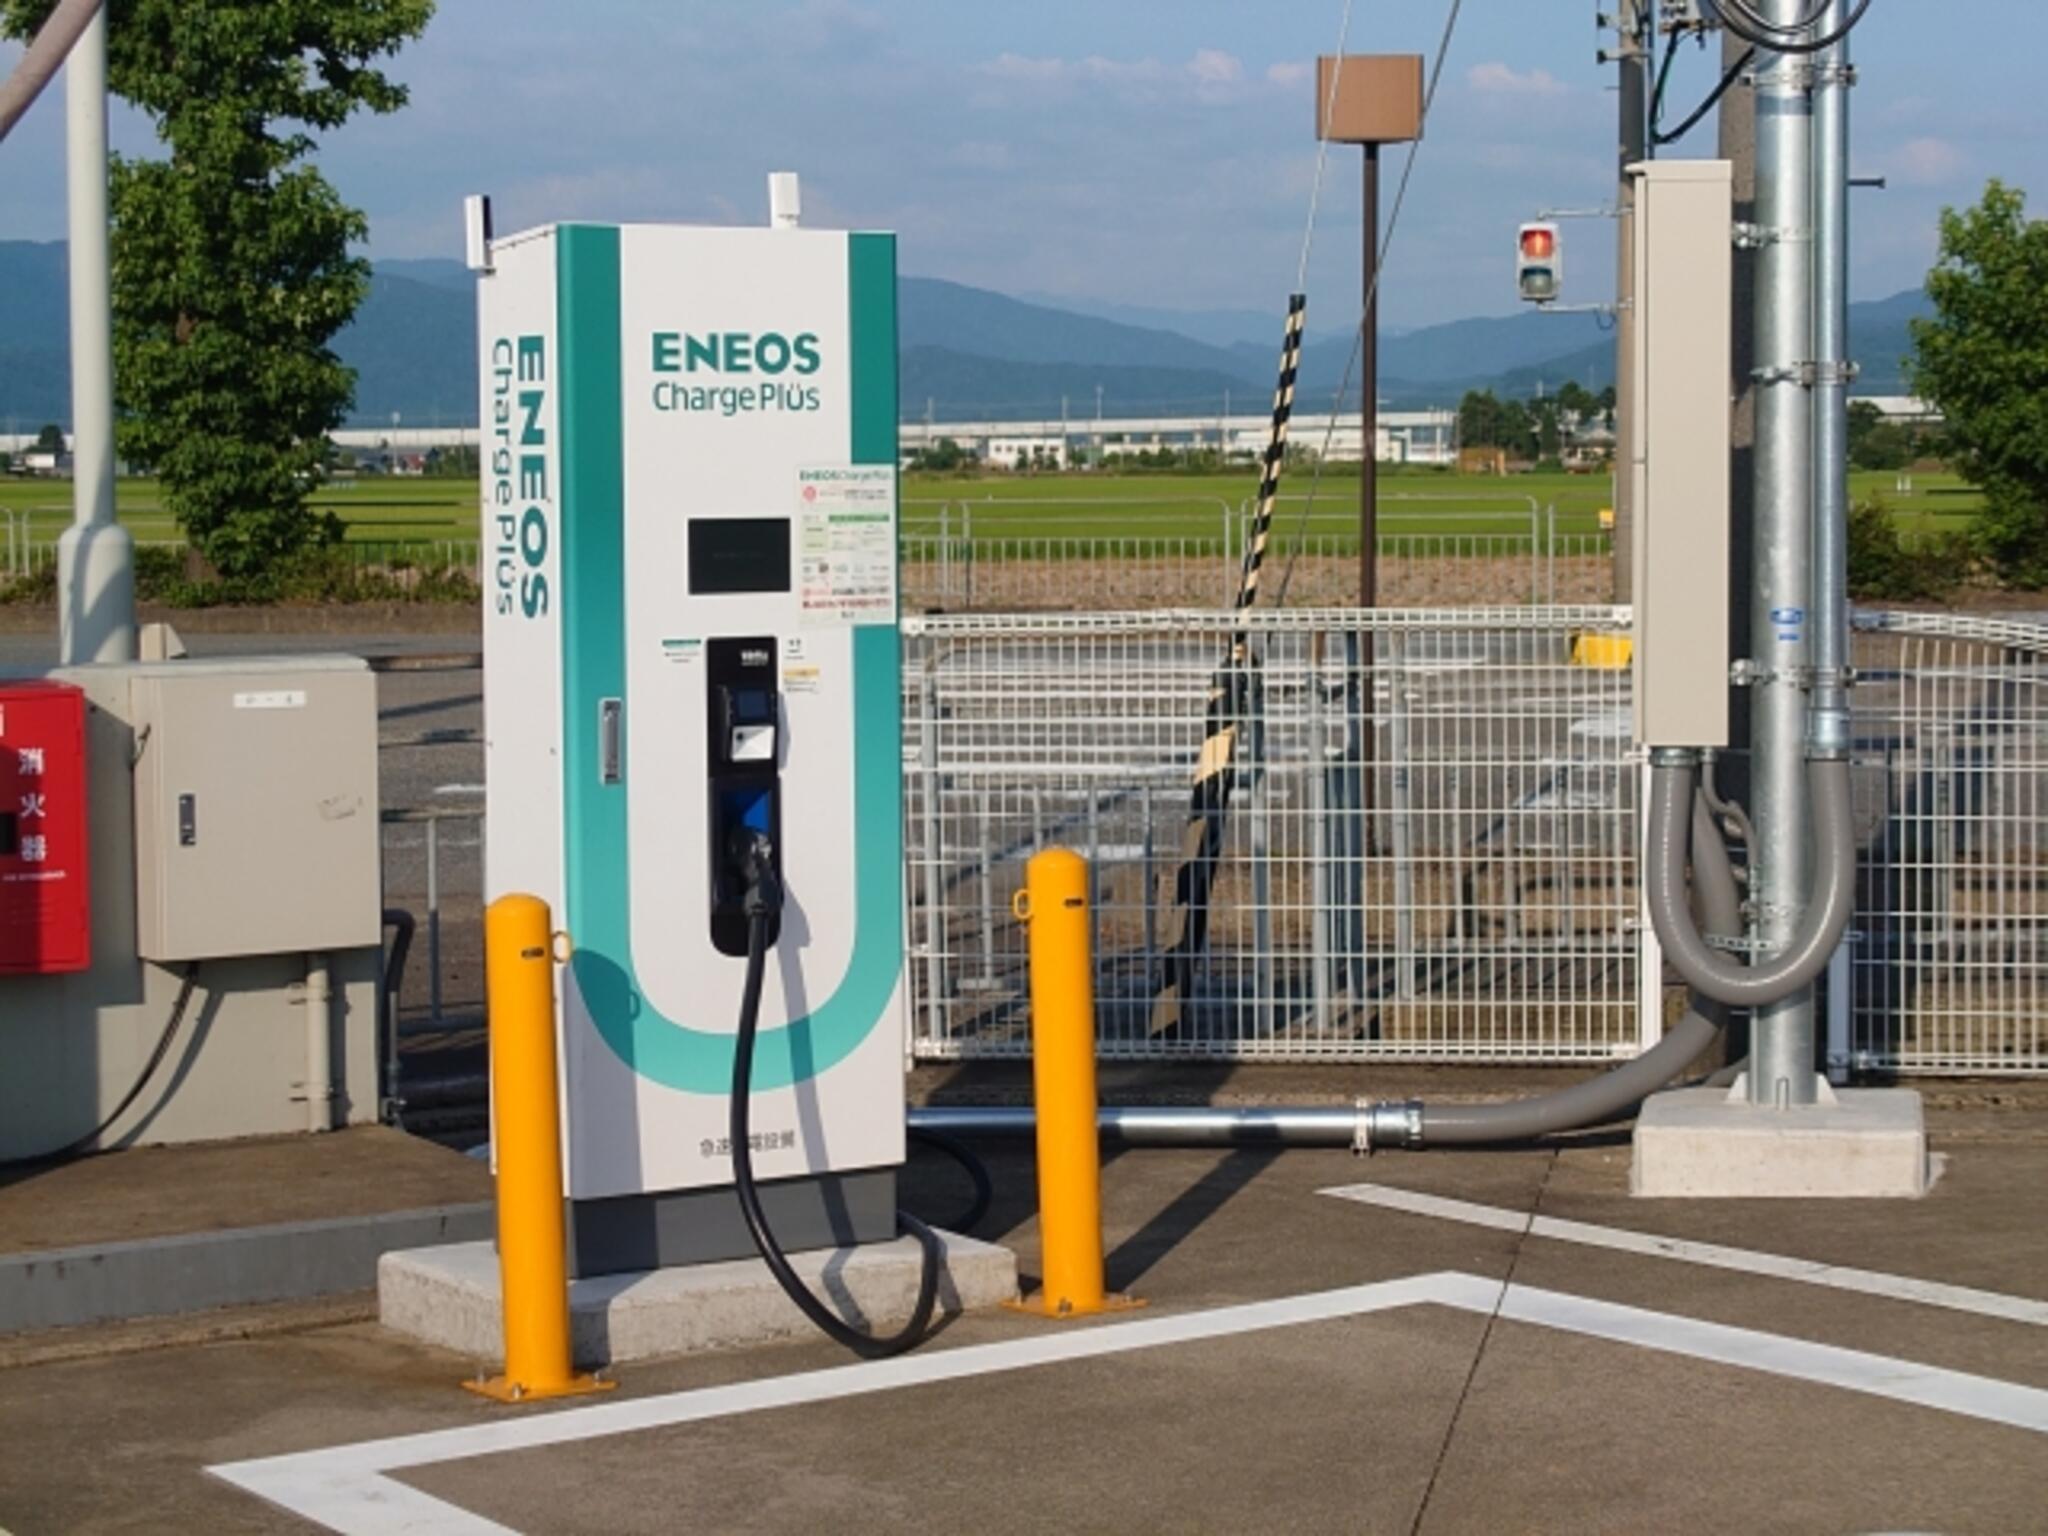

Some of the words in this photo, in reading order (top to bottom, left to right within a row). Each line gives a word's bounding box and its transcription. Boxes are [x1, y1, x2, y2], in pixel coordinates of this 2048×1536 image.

[652, 332, 820, 375] ENEOS
[653, 381, 756, 417] Charge
[492, 337, 513, 506] Charge
[518, 335, 548, 619] ENEOS
[18, 747, 47, 862] 消火器
